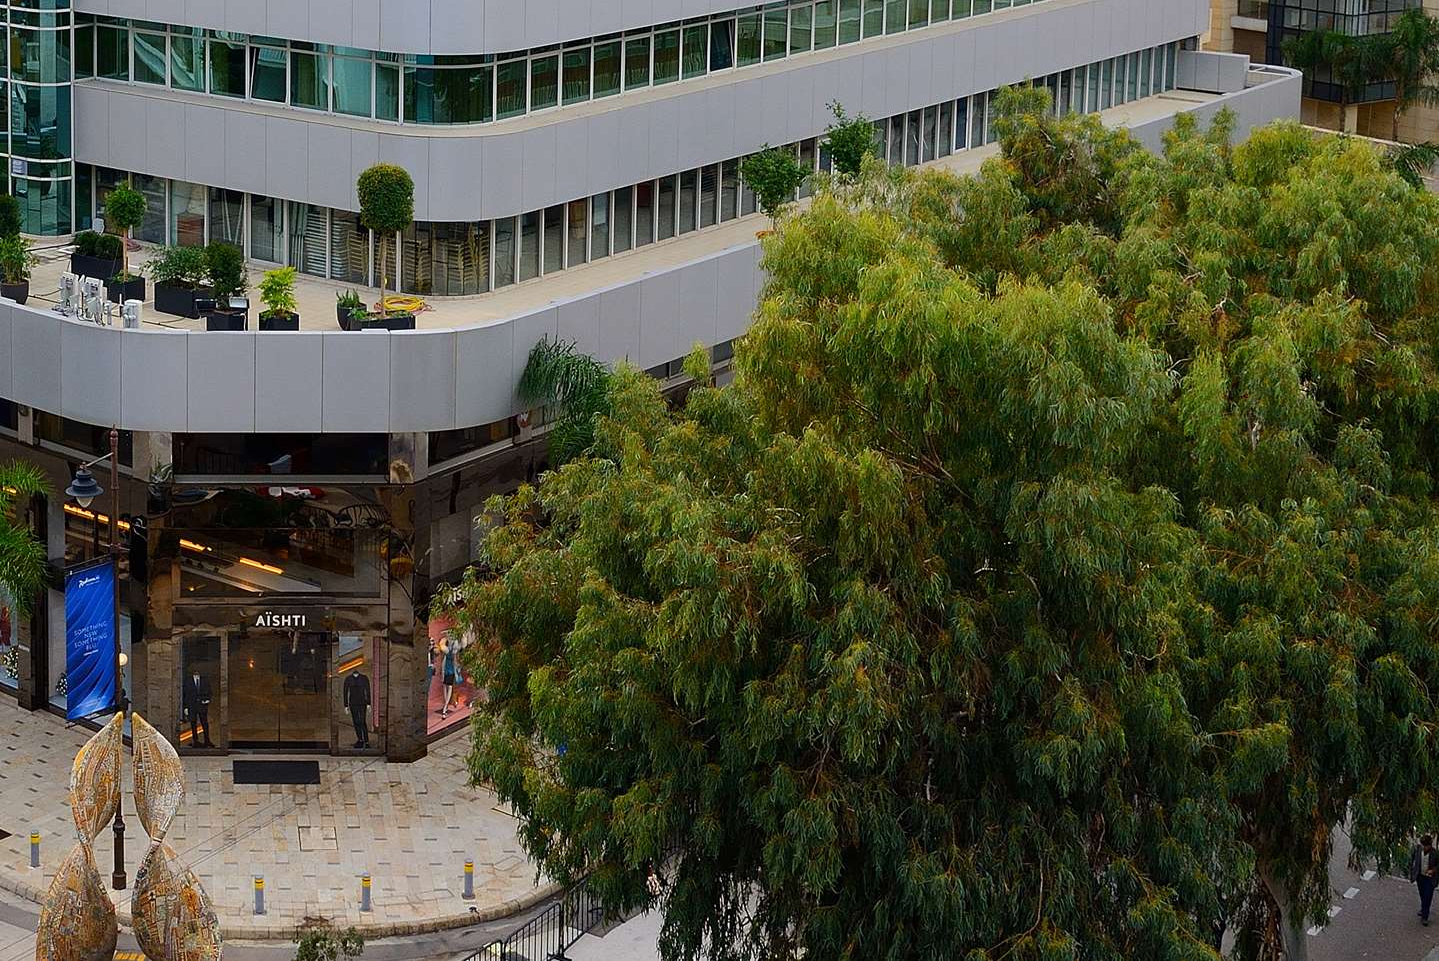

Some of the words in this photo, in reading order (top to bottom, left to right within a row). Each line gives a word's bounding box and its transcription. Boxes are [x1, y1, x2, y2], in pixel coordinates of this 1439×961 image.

[255, 611, 306, 627] AÏSHTI
[74, 620, 108, 637] SOMETHING
[74, 632, 108, 649] SOMETHING
